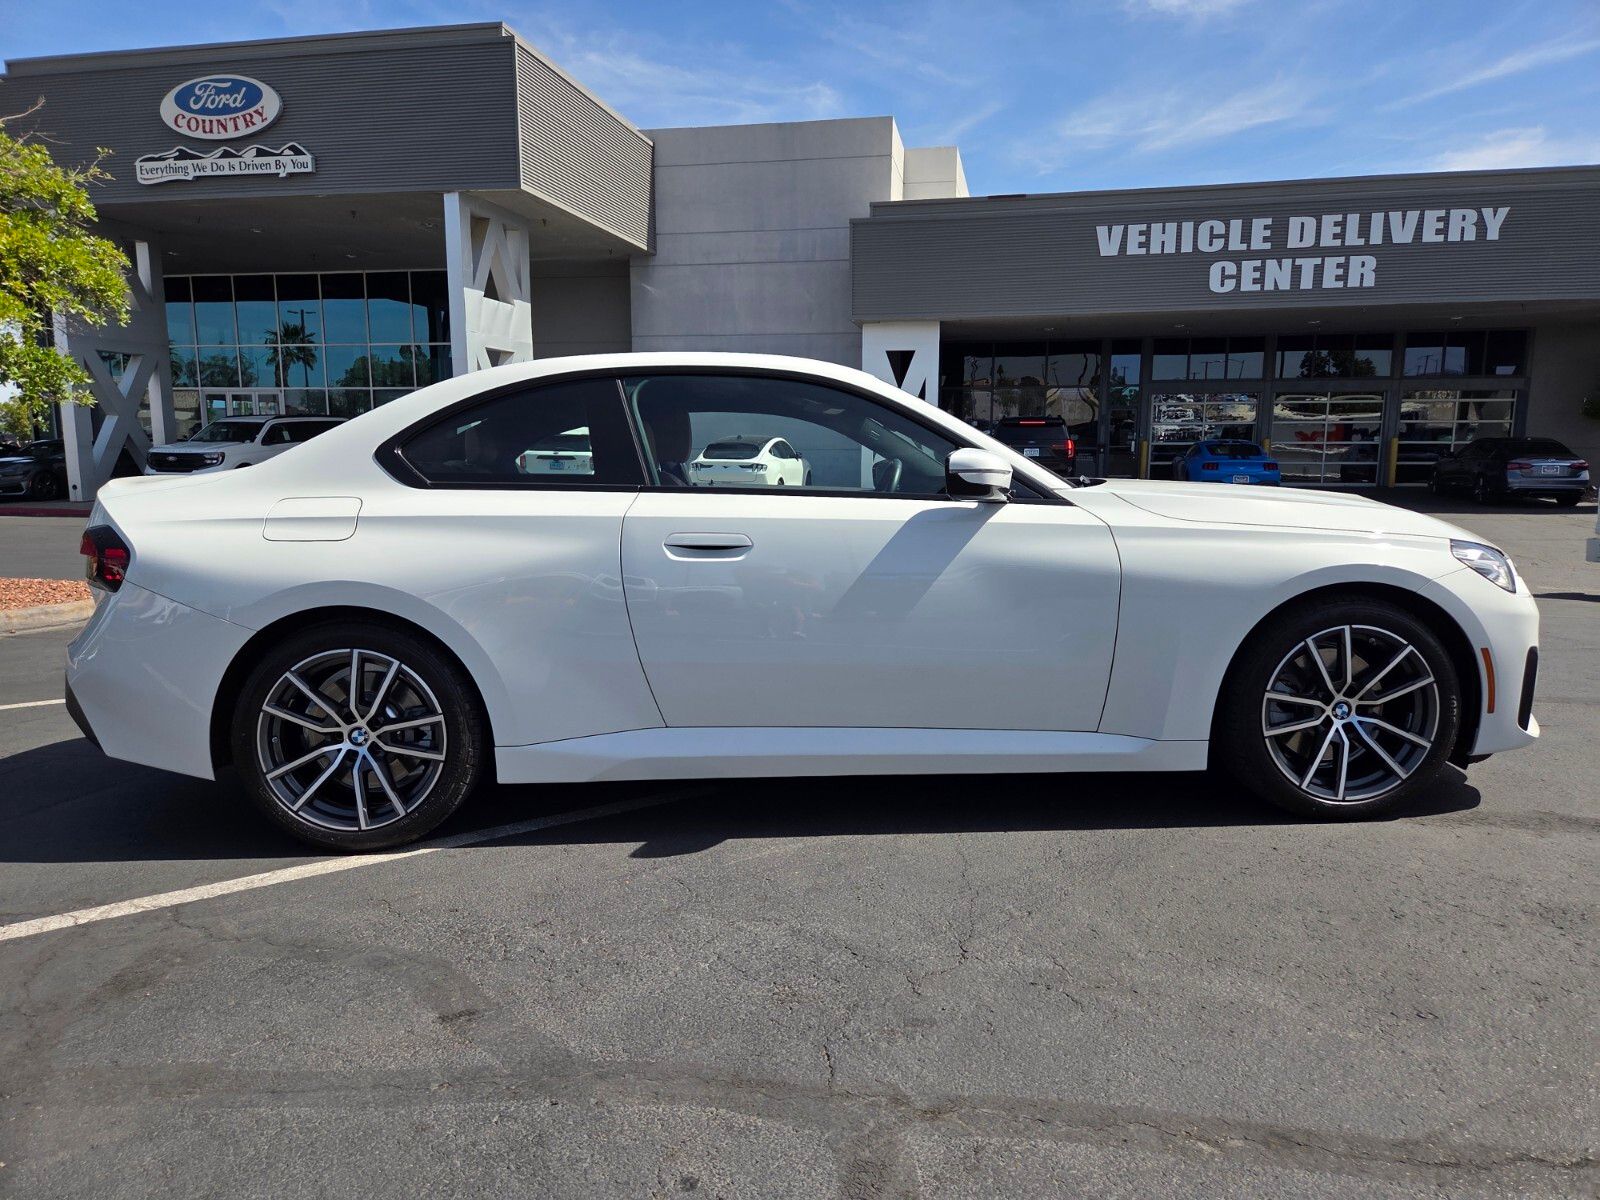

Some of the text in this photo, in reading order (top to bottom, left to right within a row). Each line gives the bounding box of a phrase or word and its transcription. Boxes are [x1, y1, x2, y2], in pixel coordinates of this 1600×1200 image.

[189, 81, 247, 110] Ford
[173, 105, 268, 135] COUNTRY
[139, 159, 309, 177] Everything We Do Is Driven By You
[1095, 206, 1511, 257] VEHICLE DELIVERY
[1208, 255, 1378, 294] CENTER
